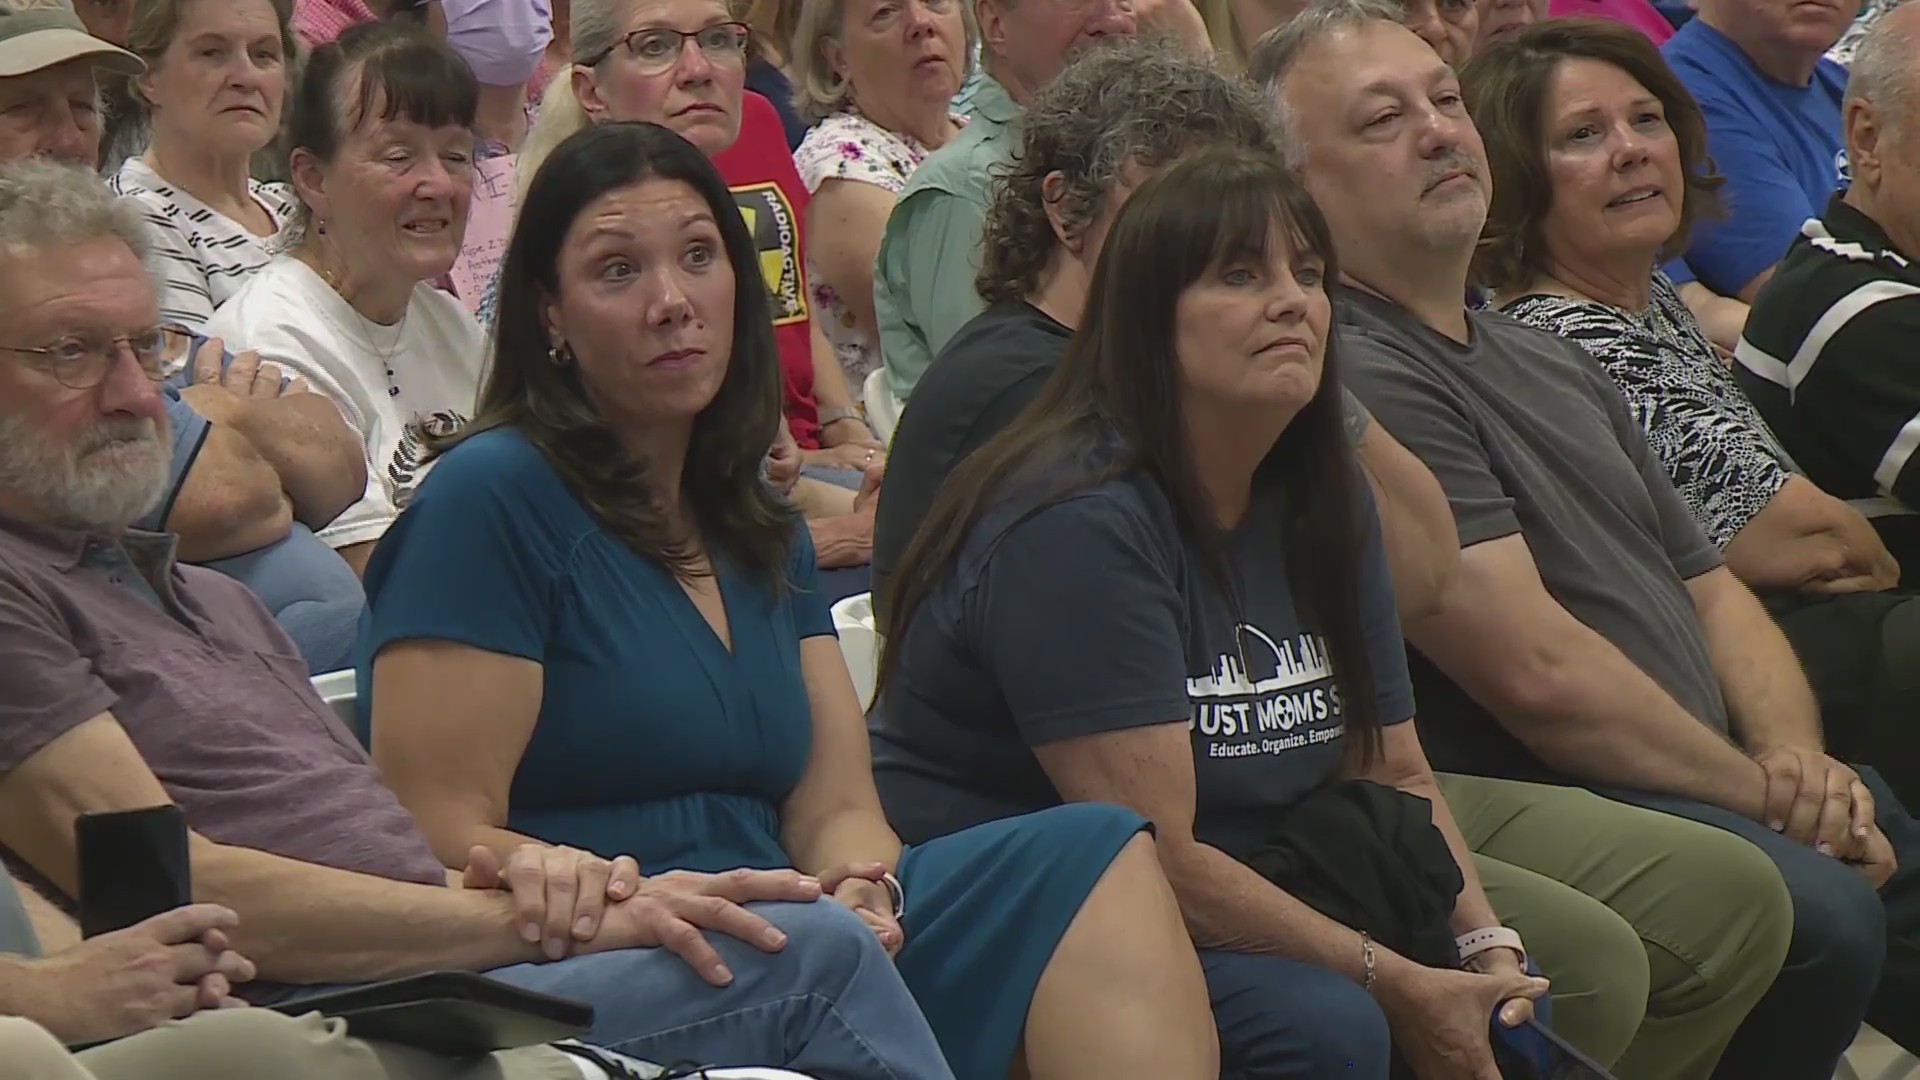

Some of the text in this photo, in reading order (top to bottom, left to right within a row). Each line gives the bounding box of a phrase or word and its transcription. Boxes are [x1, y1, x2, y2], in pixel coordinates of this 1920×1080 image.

[762, 190, 798, 313] RADIOACTIVE
[1255, 688, 1328, 732] MOMS
[1209, 741, 1261, 758] Educate.
[1262, 733, 1308, 755] Organize.
